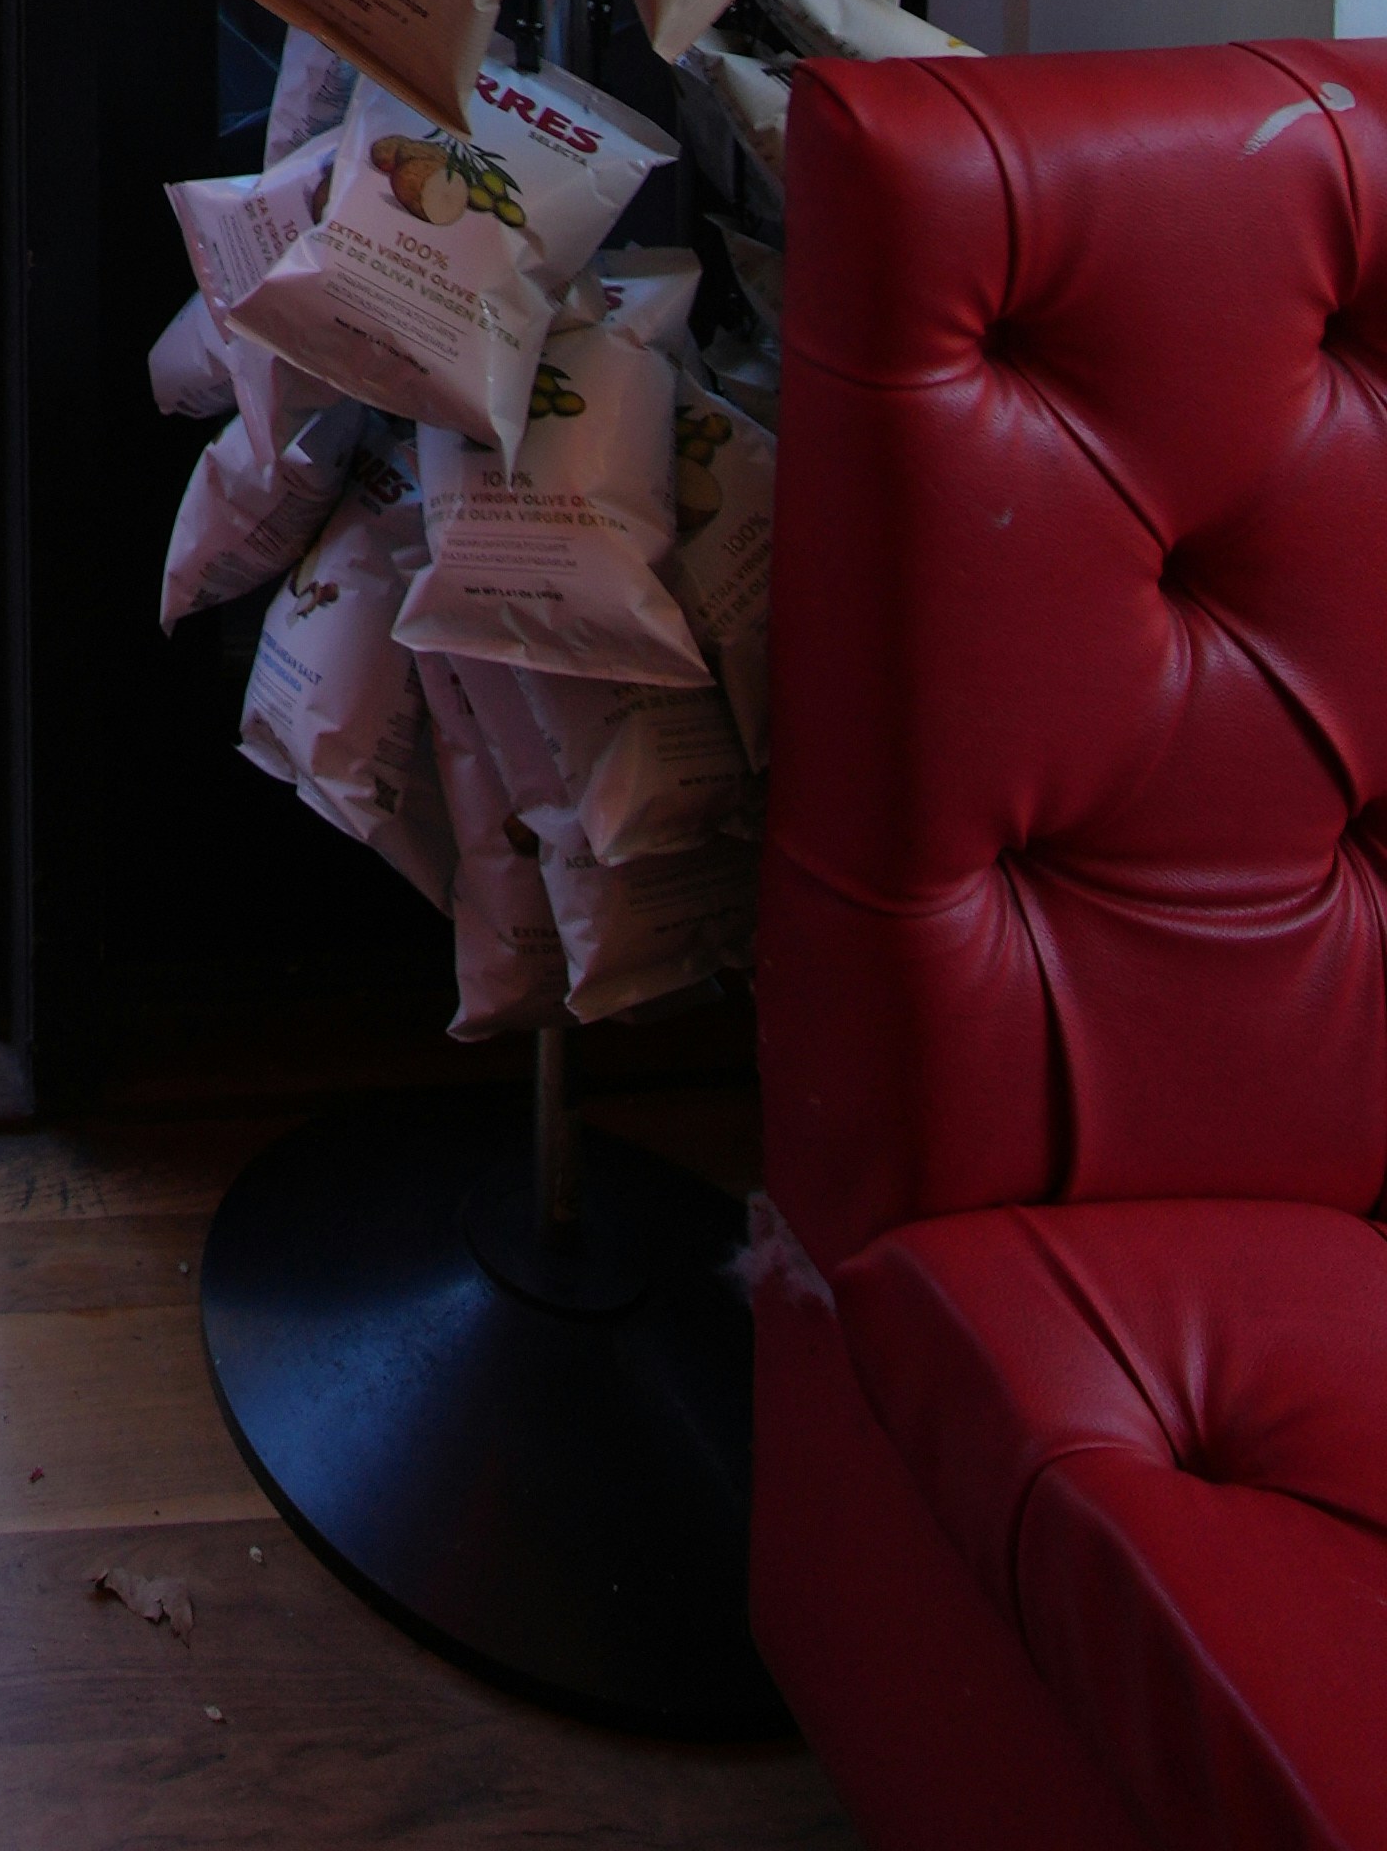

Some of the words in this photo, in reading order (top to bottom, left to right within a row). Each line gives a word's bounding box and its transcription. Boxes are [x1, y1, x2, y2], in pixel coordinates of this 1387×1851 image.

[527, 129, 589, 167] SELECTA
[326, 220, 374, 251] EXTRA
[376, 241, 428, 279] VIRGIN
[429, 272, 478, 306] OLIVE
[395, 230, 450, 272] 100%
[346, 245, 368, 265] DE
[370, 259, 416, 291] OLIVA
[419, 285, 477, 324] VIRGEN
[469, 494, 519, 506] VIRGIN
[522, 495, 567, 507] OLIVE
[470, 507, 514, 523] OLIVA
[577, 513, 629, 534] EXTRA
